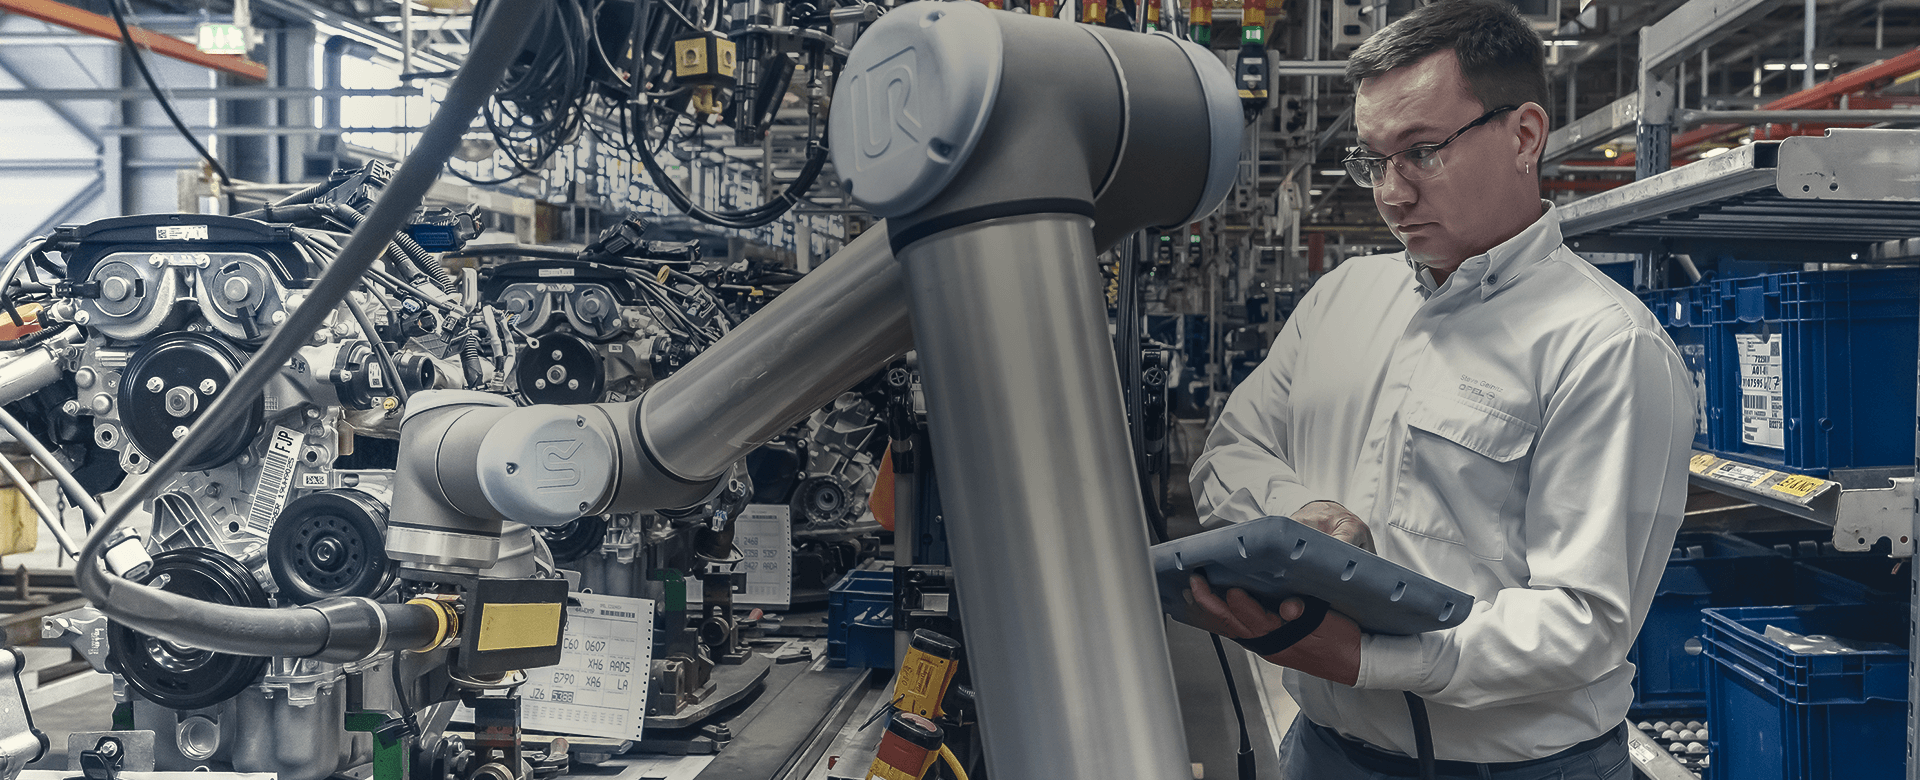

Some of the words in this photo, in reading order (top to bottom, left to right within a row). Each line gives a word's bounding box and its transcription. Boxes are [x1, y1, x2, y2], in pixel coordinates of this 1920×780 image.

[1459, 383, 1484, 397] OPEL
[275, 430, 294, 454] FJP
[585, 640, 605, 652] 0607
[588, 658, 603, 670] XH6
[553, 672, 574, 685] 8790
[586, 676, 601, 688] XA6
[617, 679, 628, 690] LA
[530, 688, 545, 700] JZ6
